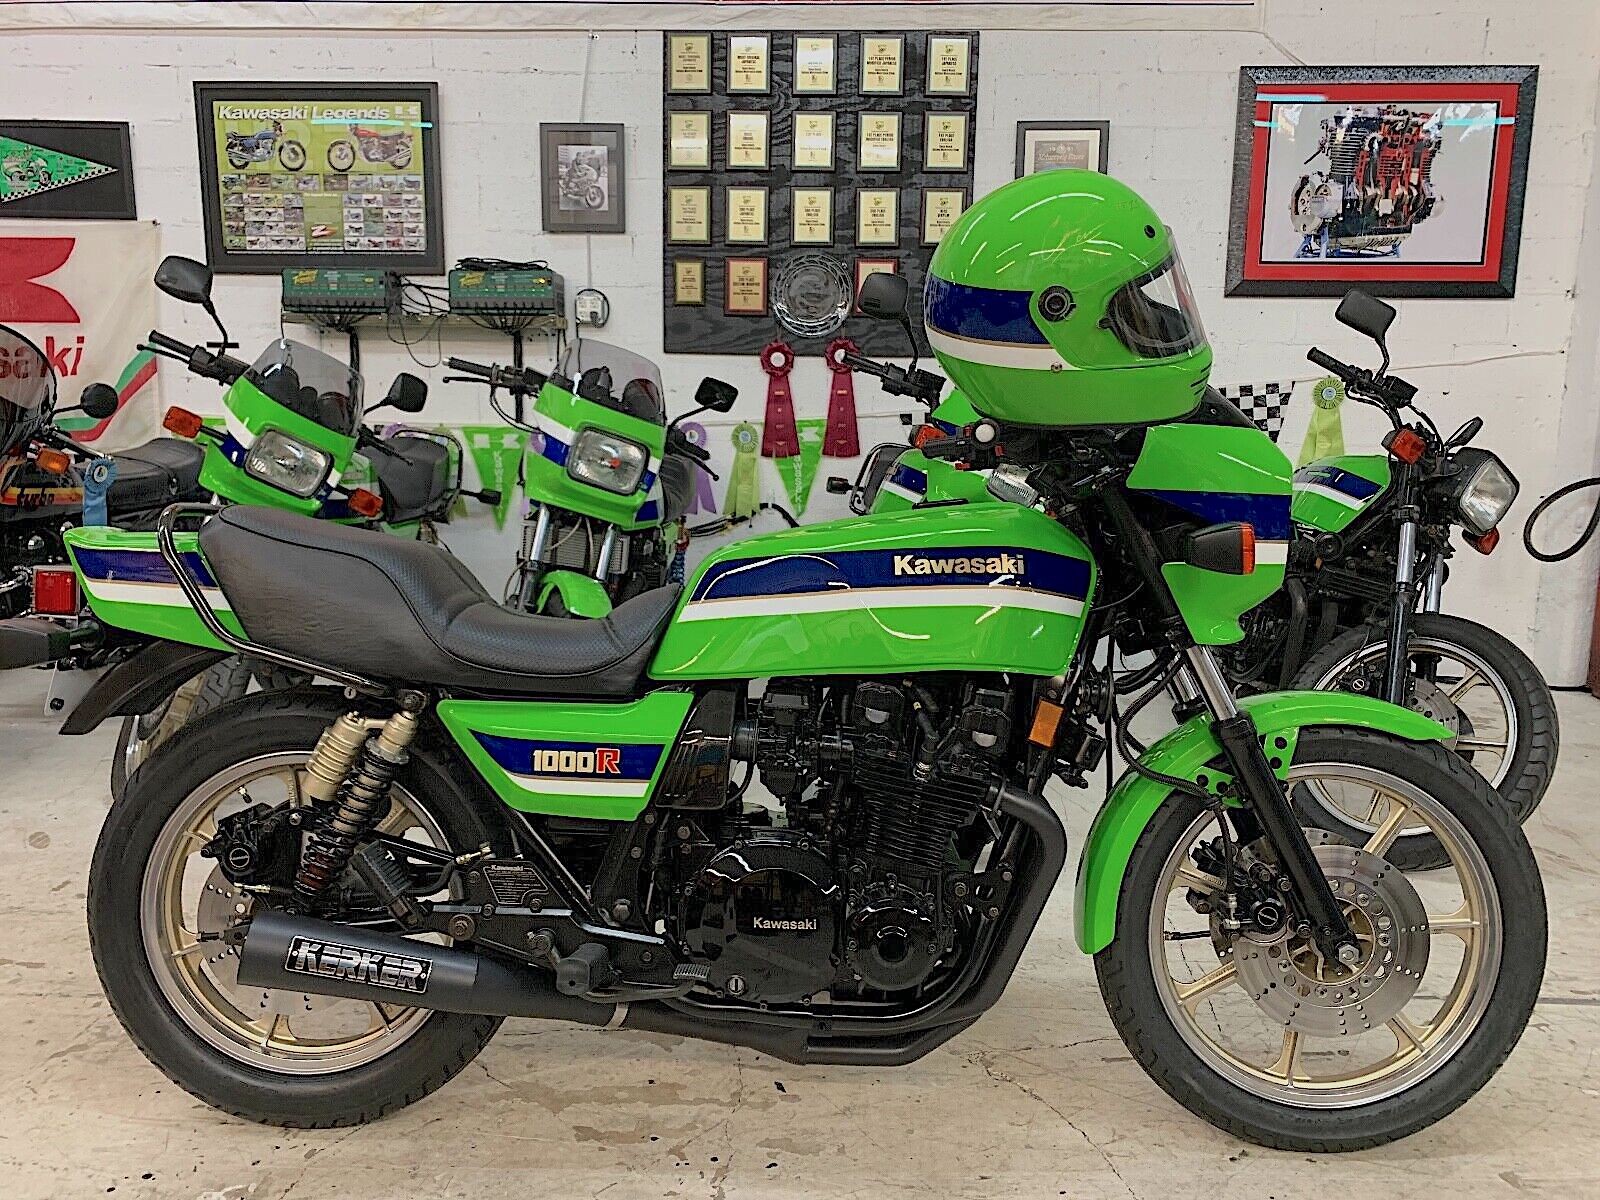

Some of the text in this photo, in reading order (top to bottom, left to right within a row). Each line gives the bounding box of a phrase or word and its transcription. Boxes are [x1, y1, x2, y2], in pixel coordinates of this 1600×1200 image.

[219, 105, 391, 120] Kawasaki Legends
[893, 554, 1025, 576] Kawasaki
[533, 748, 621, 774] 1000R
[753, 916, 817, 930] Kawasaki
[294, 941, 424, 989] KERKER
